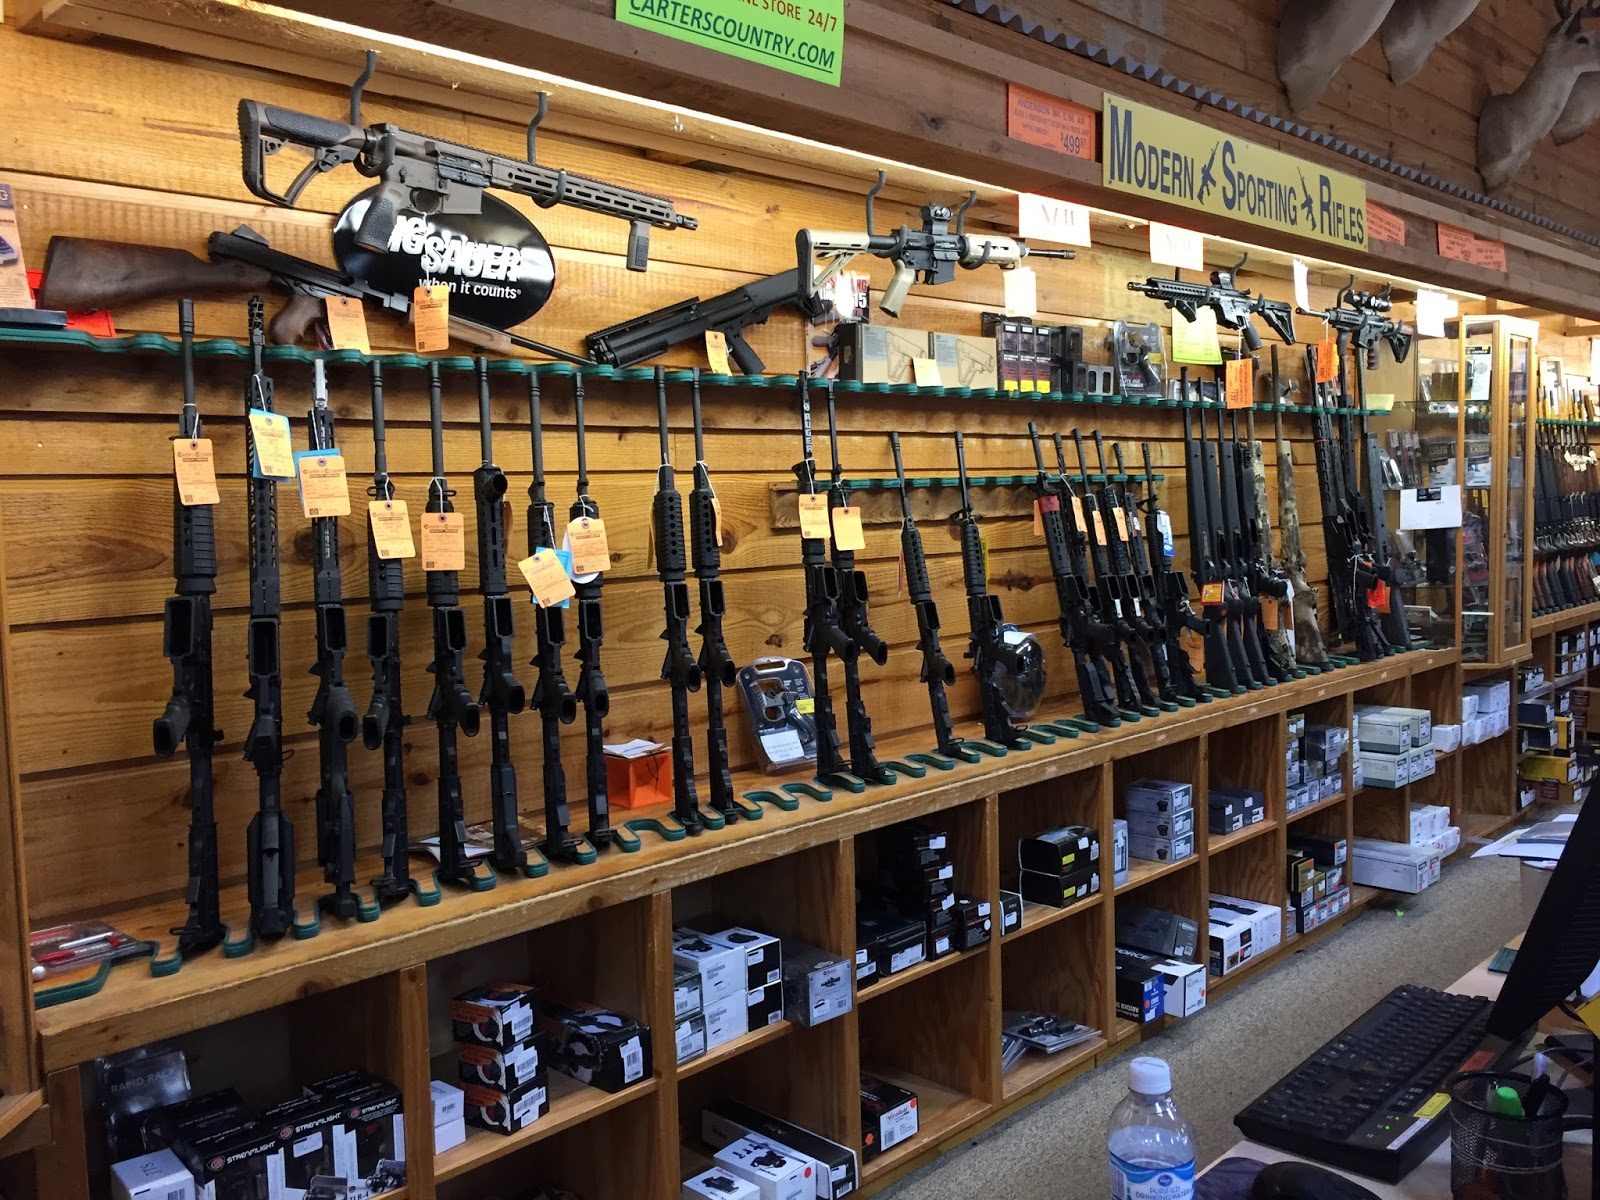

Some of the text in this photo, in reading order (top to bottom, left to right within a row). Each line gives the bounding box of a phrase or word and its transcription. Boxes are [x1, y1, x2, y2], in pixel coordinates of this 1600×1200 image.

[630, 0, 835, 69] CARTERSCOUNTRY.COM
[762, 0, 837, 32] STORE 24/7
[1109, 104, 1364, 245] MODERN SPORTING RIFLES
[420, 235, 521, 282] SAUER
[460, 280, 470, 295] it
